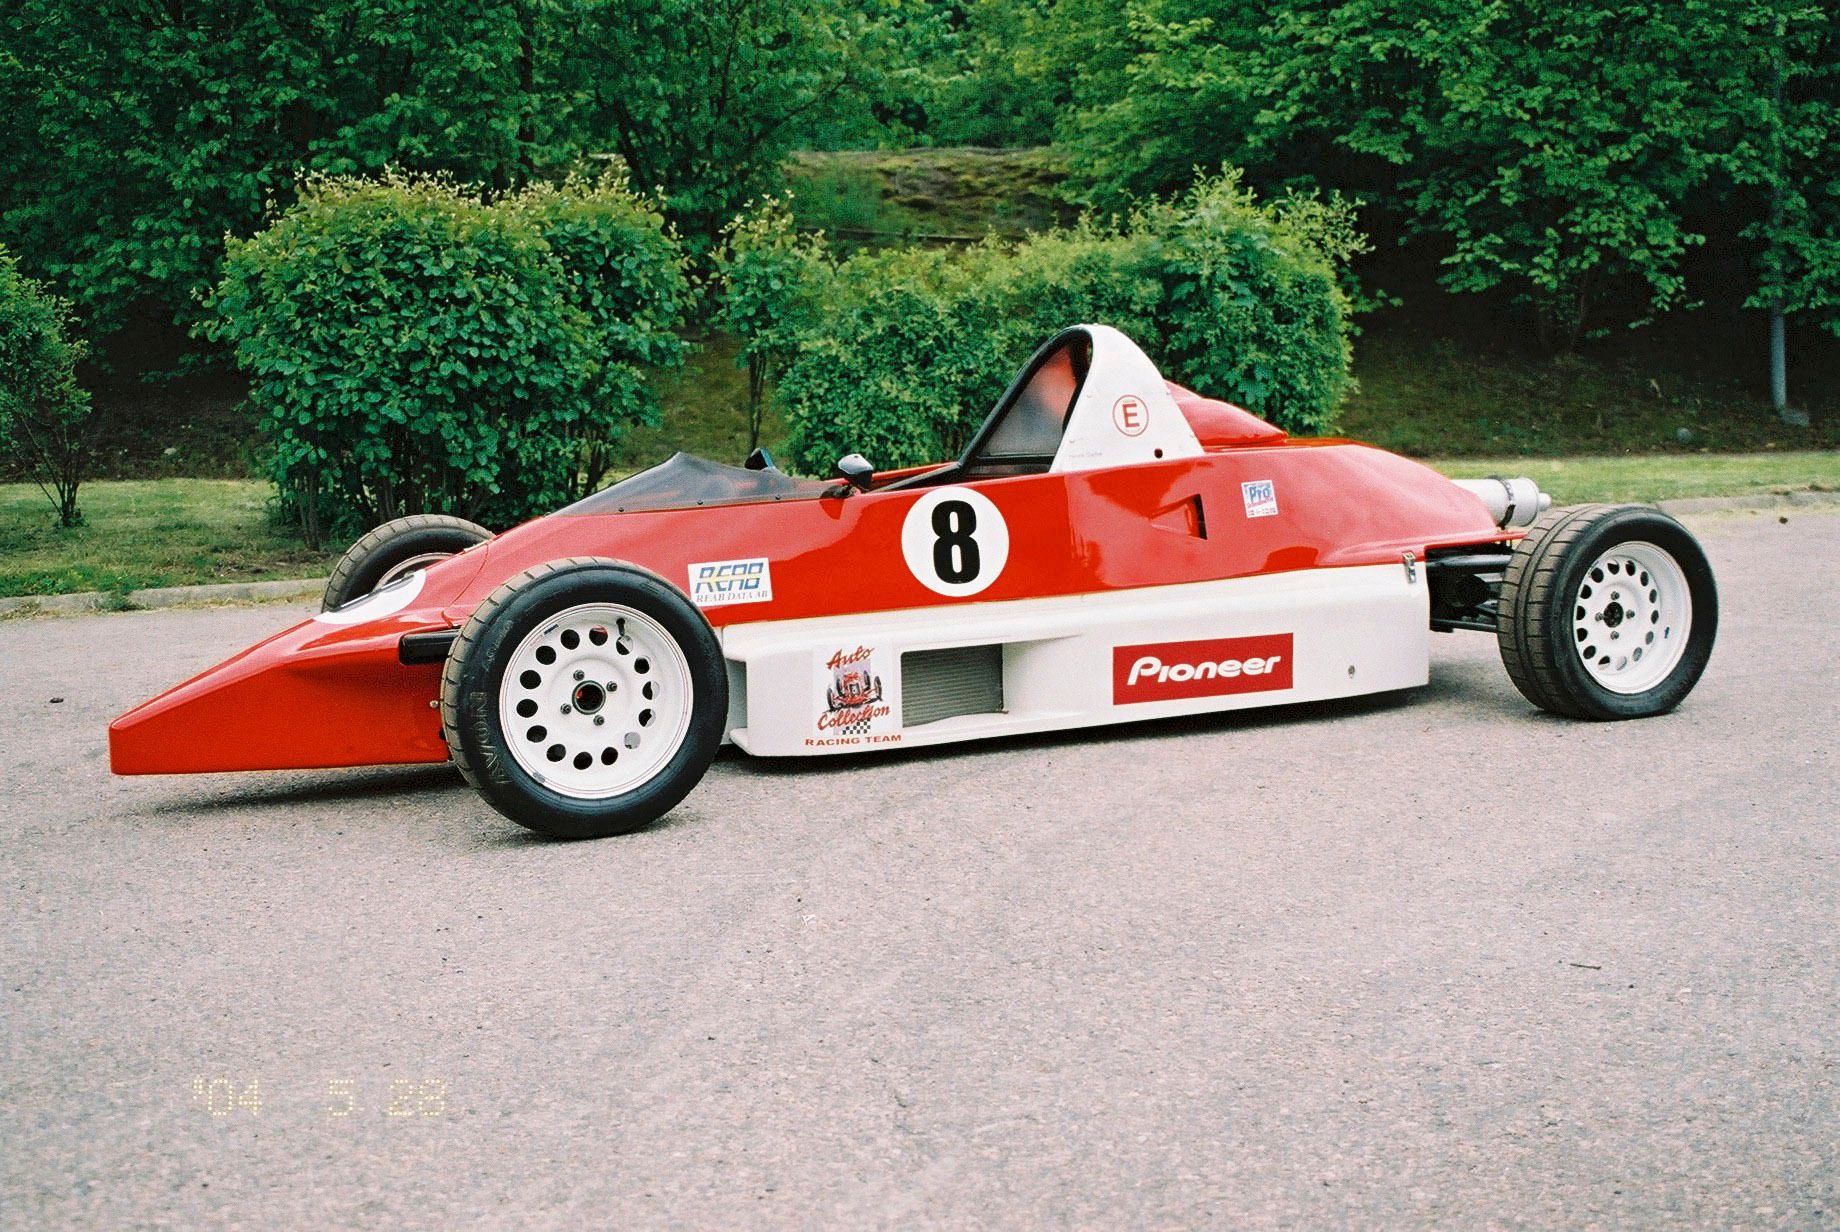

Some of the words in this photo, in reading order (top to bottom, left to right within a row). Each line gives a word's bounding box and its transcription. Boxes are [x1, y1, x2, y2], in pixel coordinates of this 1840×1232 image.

[1122, 402, 1140, 428] E
[931, 499, 981, 584] 8
[727, 591, 754, 601] DATA
[826, 645, 876, 670] Auto
[1127, 655, 1281, 686] Pioneer
[817, 704, 890, 730] Collection
[805, 737, 861, 747] RACING
[865, 734, 902, 743] TEAM
